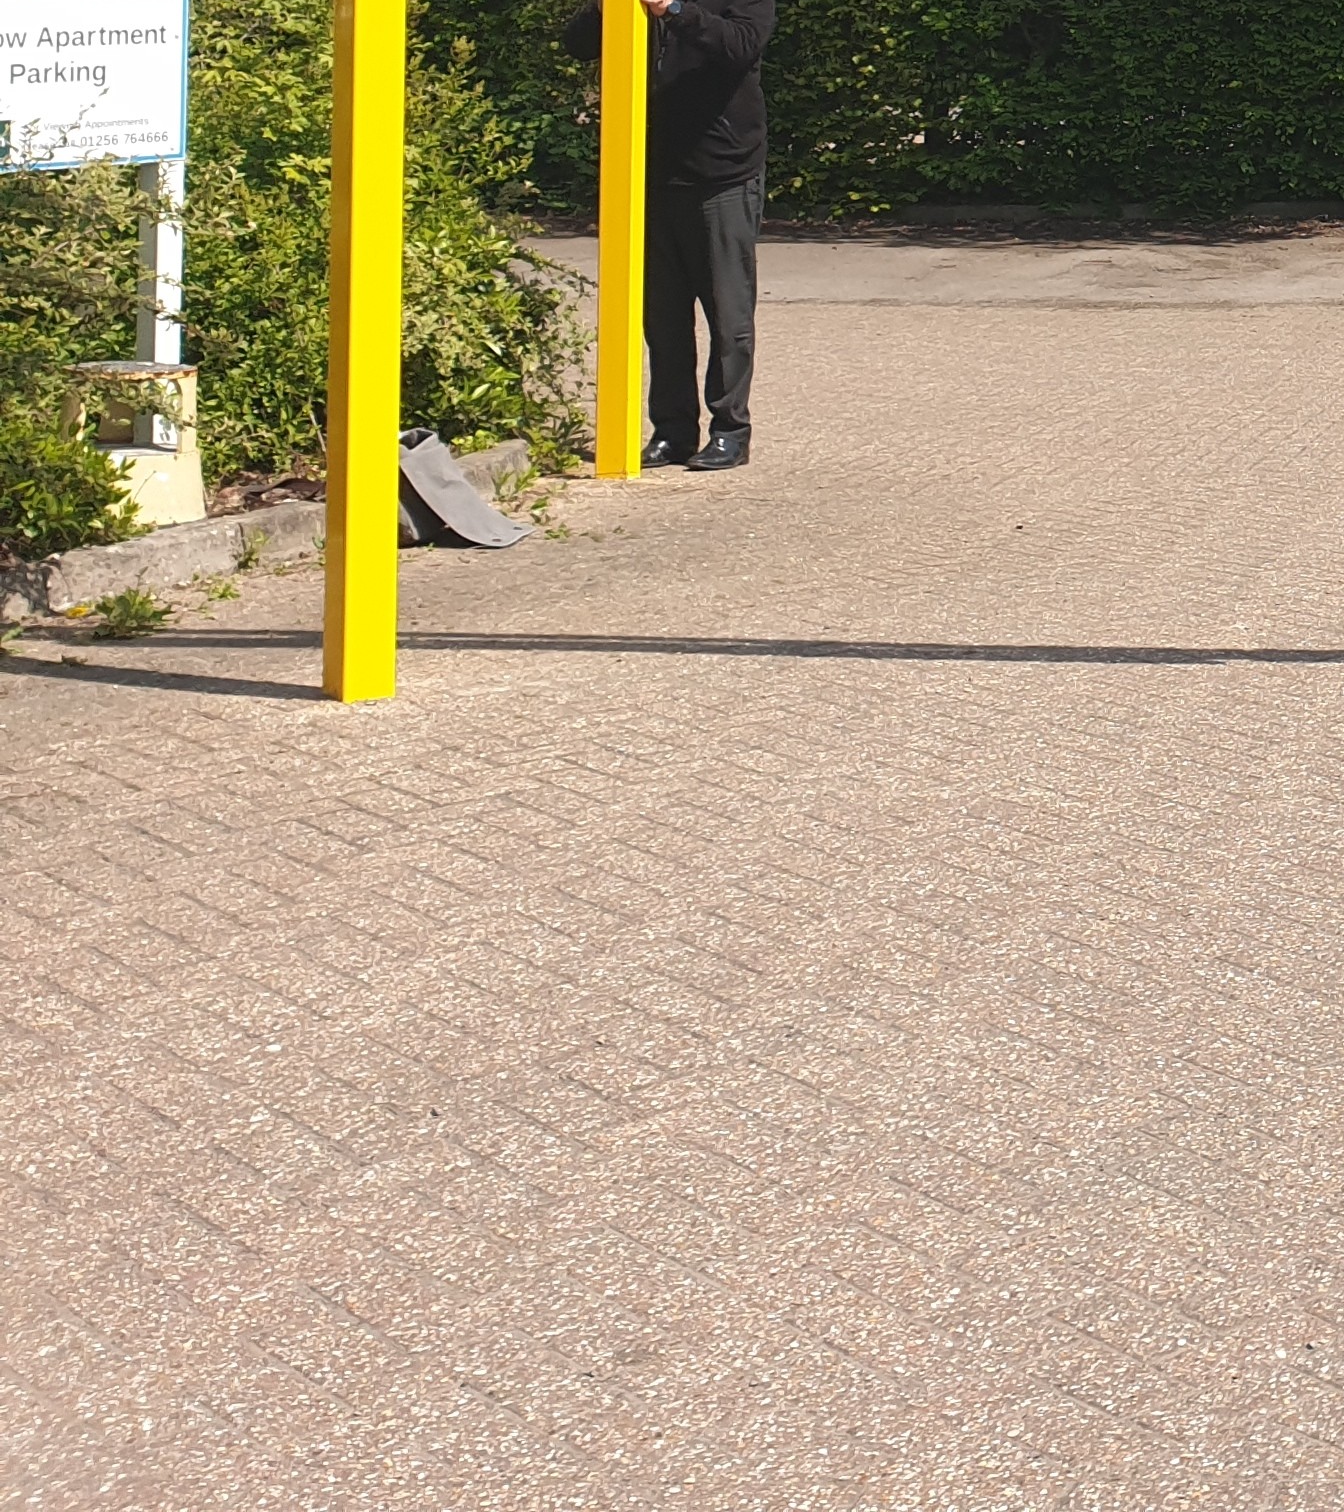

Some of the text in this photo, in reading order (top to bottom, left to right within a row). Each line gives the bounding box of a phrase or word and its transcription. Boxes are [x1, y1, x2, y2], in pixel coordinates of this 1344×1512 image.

[36, 25, 166, 53] Apartment
[10, 60, 106, 87] Parking
[84, 117, 149, 129] Appointments
[80, 135, 119, 147] 01256
[123, 131, 169, 144] 764666
